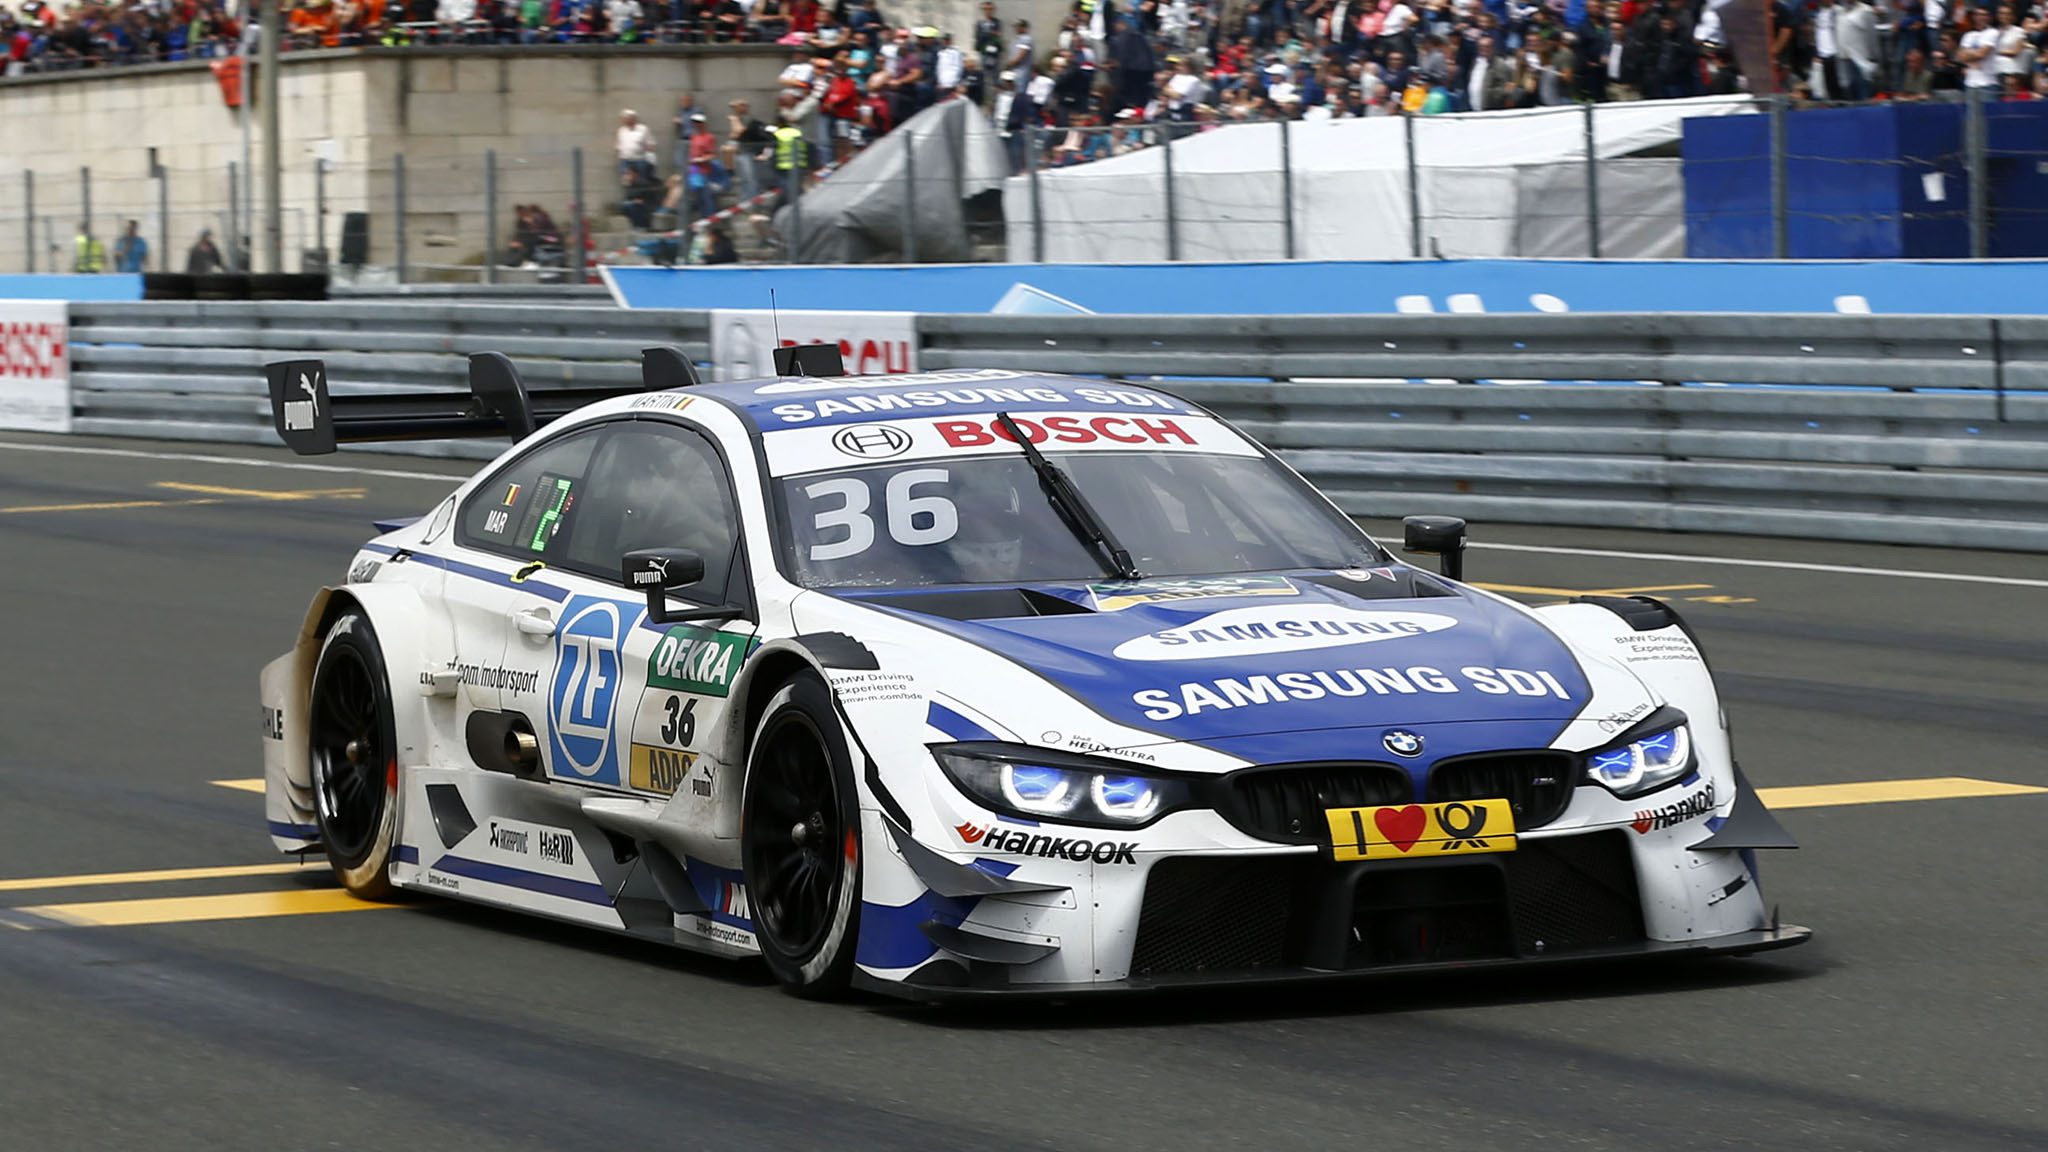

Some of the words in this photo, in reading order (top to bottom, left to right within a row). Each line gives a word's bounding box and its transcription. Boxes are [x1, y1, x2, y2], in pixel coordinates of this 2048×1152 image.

[772, 388, 1069, 423] SAMSUNG
[1074, 388, 1176, 410] SDI
[933, 416, 1199, 448] BOSCH
[484, 509, 508, 535] MAR
[804, 468, 959, 561] 36
[633, 571, 661, 585] PUMA
[1157, 619, 1428, 646] SAMSUNG
[656, 635, 735, 686] DEKRA
[559, 632, 616, 740] ZF
[831, 674, 865, 686] BMW
[867, 673, 915, 682] Driving
[837, 683, 907, 696] Experience
[1132, 666, 1460, 721] SAMSUNG
[1460, 666, 1572, 700] SDI
[661, 695, 699, 748] 36
[1653, 780, 1717, 831] Hankoo
